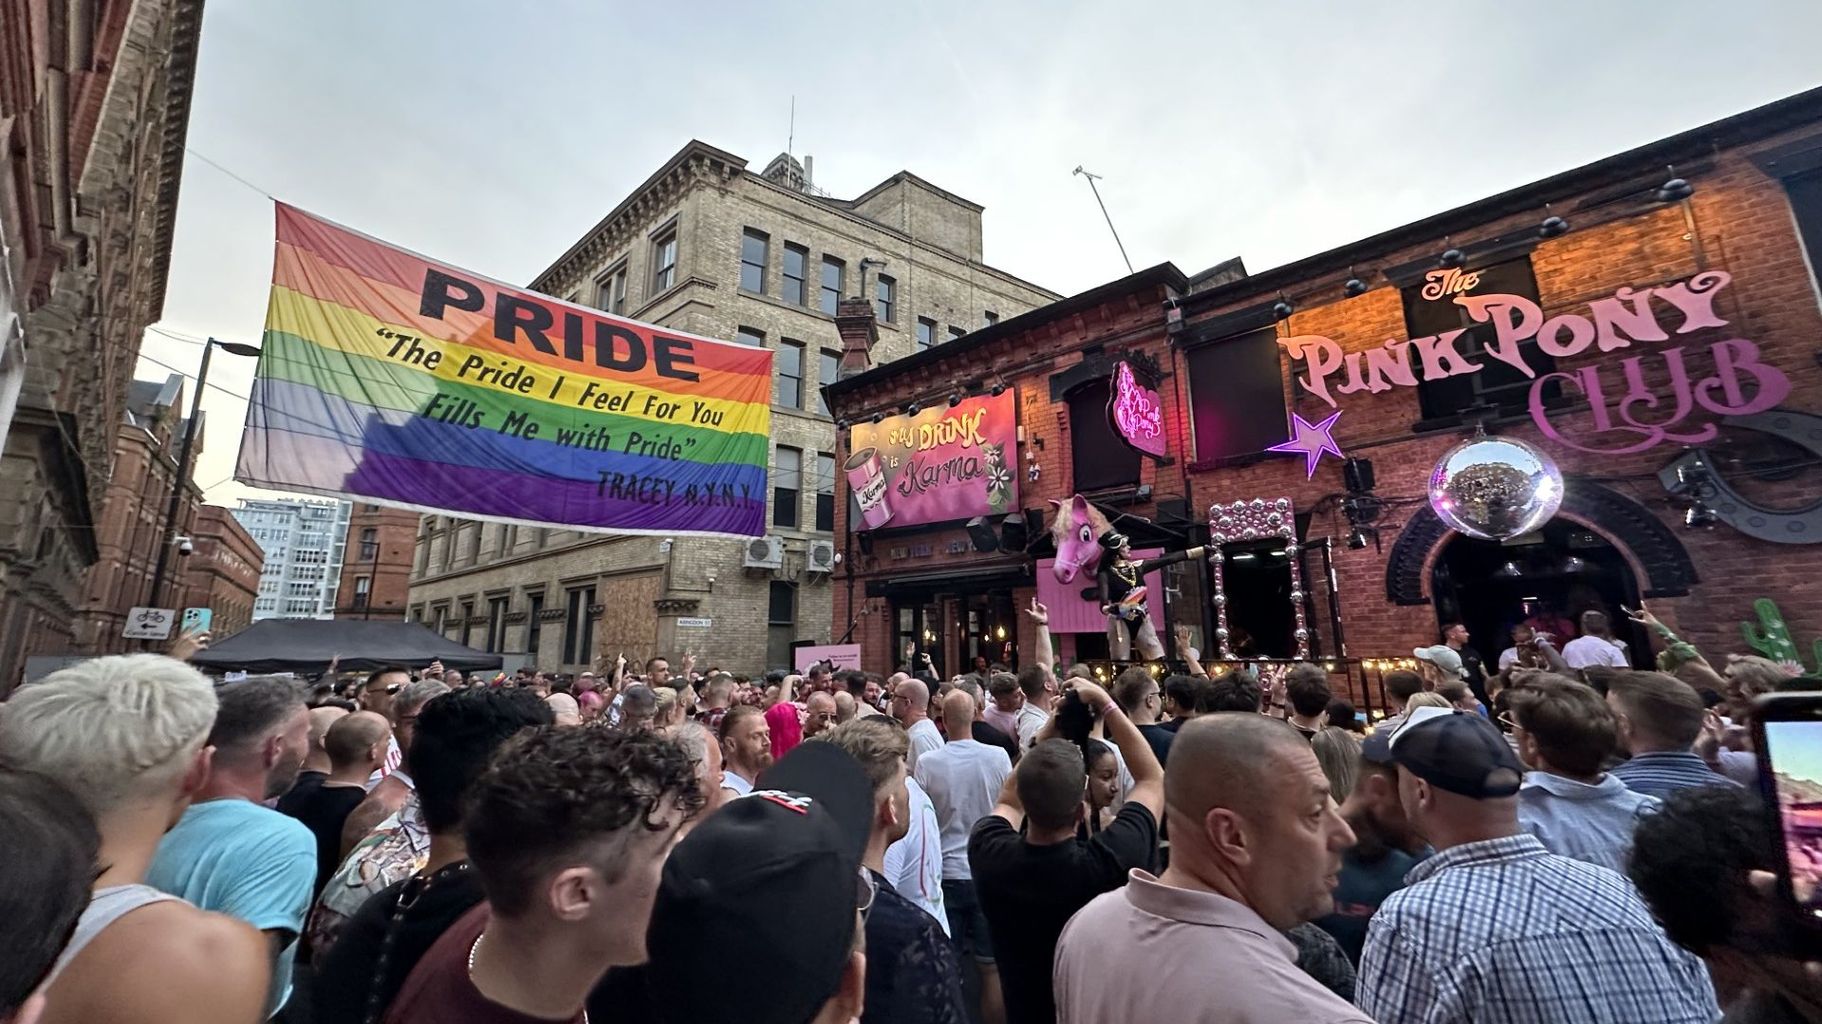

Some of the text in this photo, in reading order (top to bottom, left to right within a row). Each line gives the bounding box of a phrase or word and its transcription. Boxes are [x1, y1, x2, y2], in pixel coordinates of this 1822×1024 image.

[1422, 267, 1480, 301] The
[419, 268, 700, 383] PRIDE
[1453, 270, 1733, 379] PONY
[459, 354, 536, 395] Pride
[549, 375, 563, 399] I
[577, 382, 633, 414] Feel
[644, 395, 682, 421] For
[691, 399, 725, 427] You
[421, 392, 486, 430] Fills
[499, 409, 537, 441] Me
[556, 424, 611, 452] with
[889, 455, 899, 470] is
[898, 456, 984, 497] Karma
[597, 471, 676, 506] TRACEY
[861, 478, 885, 504] Karma
